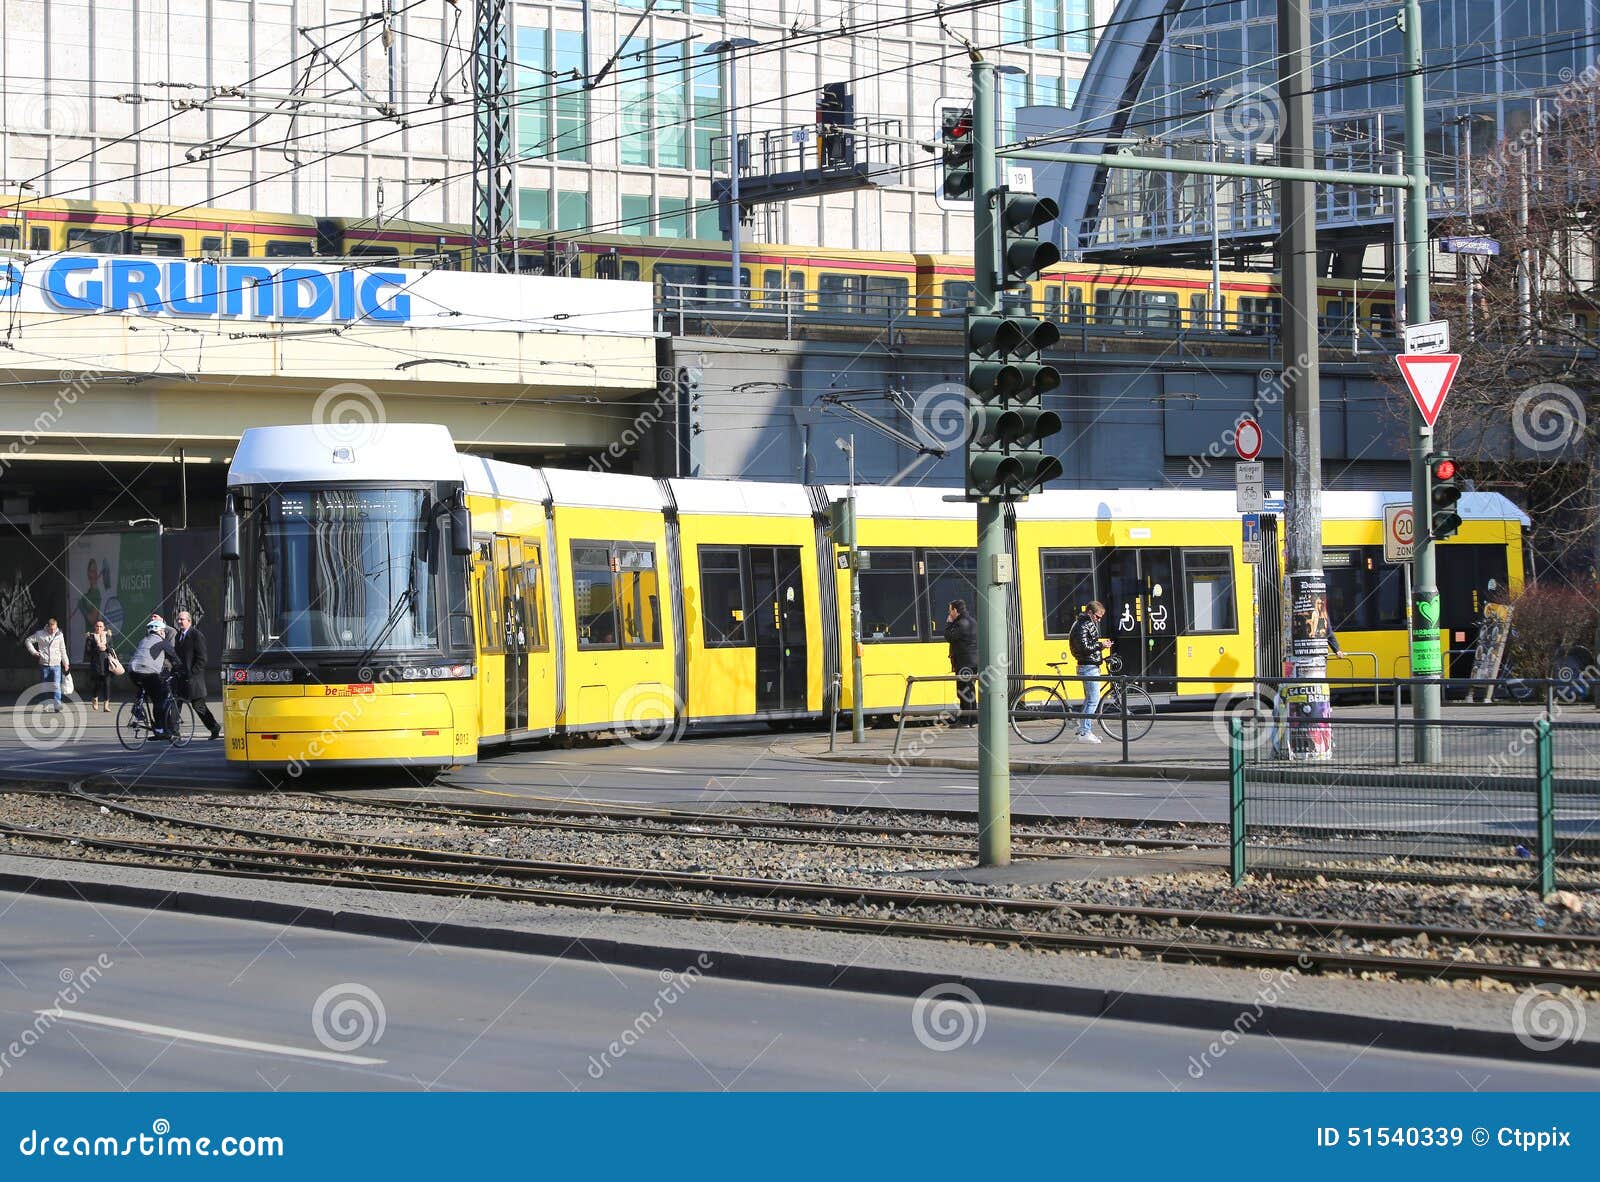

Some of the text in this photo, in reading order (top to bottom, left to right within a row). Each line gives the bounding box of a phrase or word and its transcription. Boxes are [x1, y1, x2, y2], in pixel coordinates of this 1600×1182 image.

[1013, 173, 1027, 185] 191
[46, 256, 411, 321] GRUNDIG
[1398, 519, 1413, 535] 20
[120, 574, 153, 592] WISCHT
[325, 685, 338, 696] be
[1299, 686, 1322, 695] CLUB
